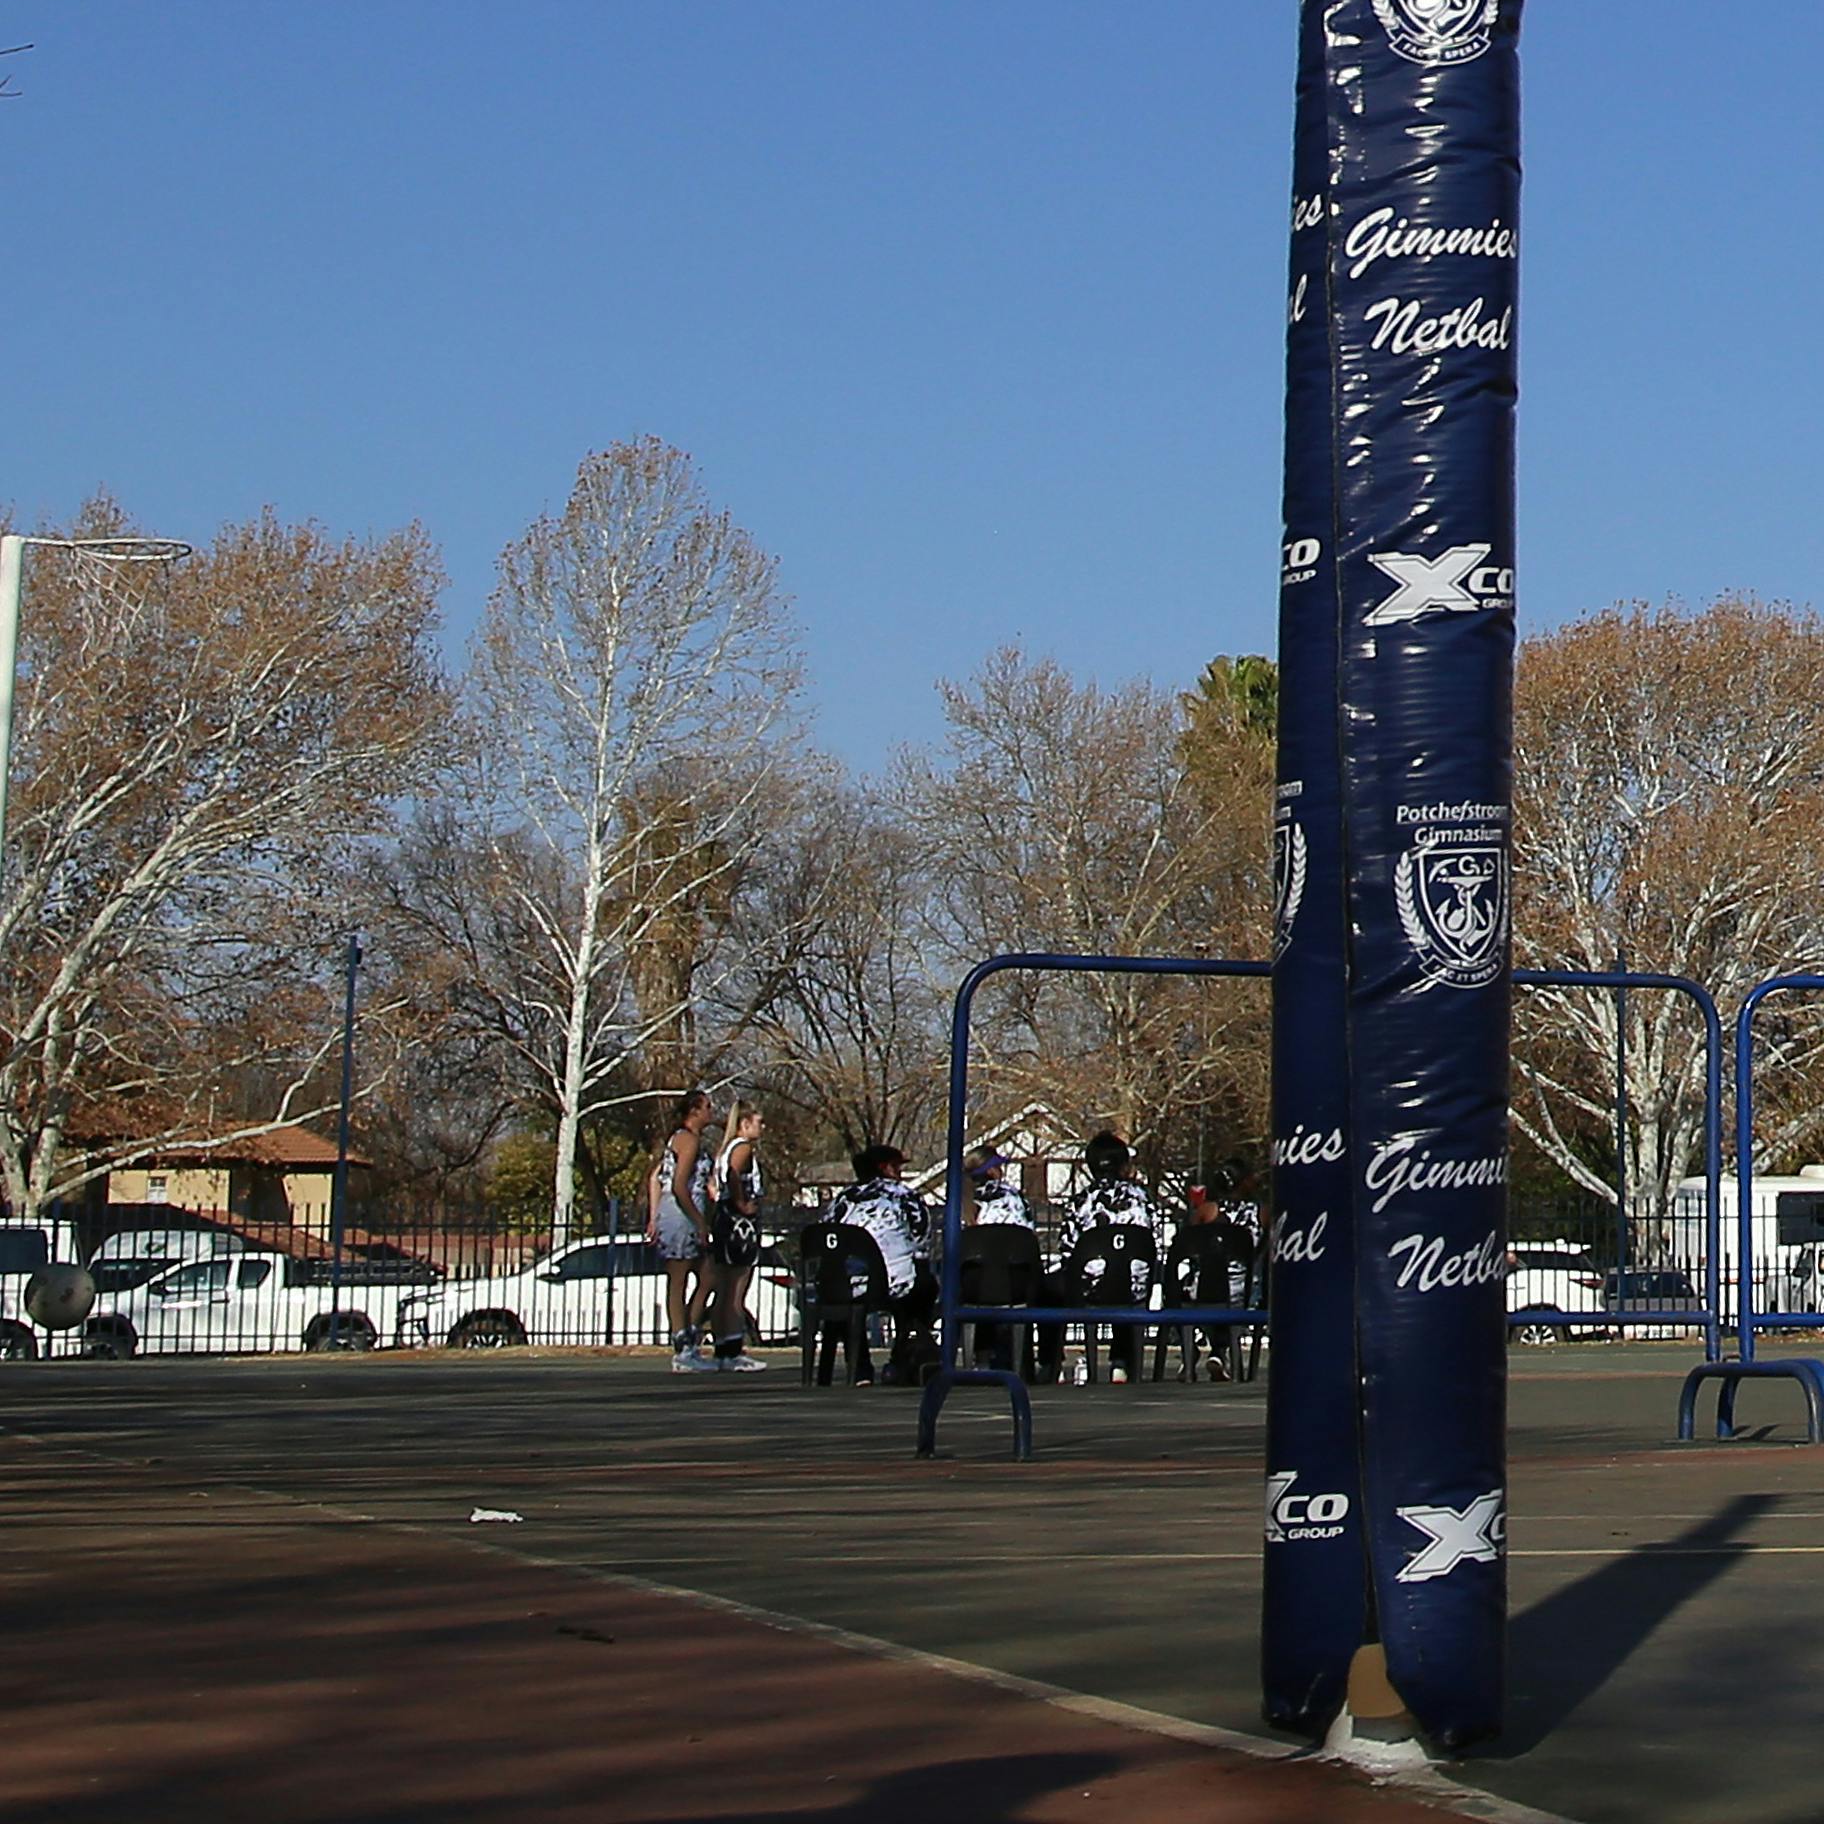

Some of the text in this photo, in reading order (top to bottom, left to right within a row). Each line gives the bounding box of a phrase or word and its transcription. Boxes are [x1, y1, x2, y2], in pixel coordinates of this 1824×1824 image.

[1363, 296, 1512, 355] Netbal
[1365, 1136, 1508, 1214] Gimmi
[826, 1233, 838, 1249] G
[1112, 1234, 1125, 1250] G
[1387, 1230, 1506, 1293] Netba
[1287, 1526, 1345, 1540] GROUP
